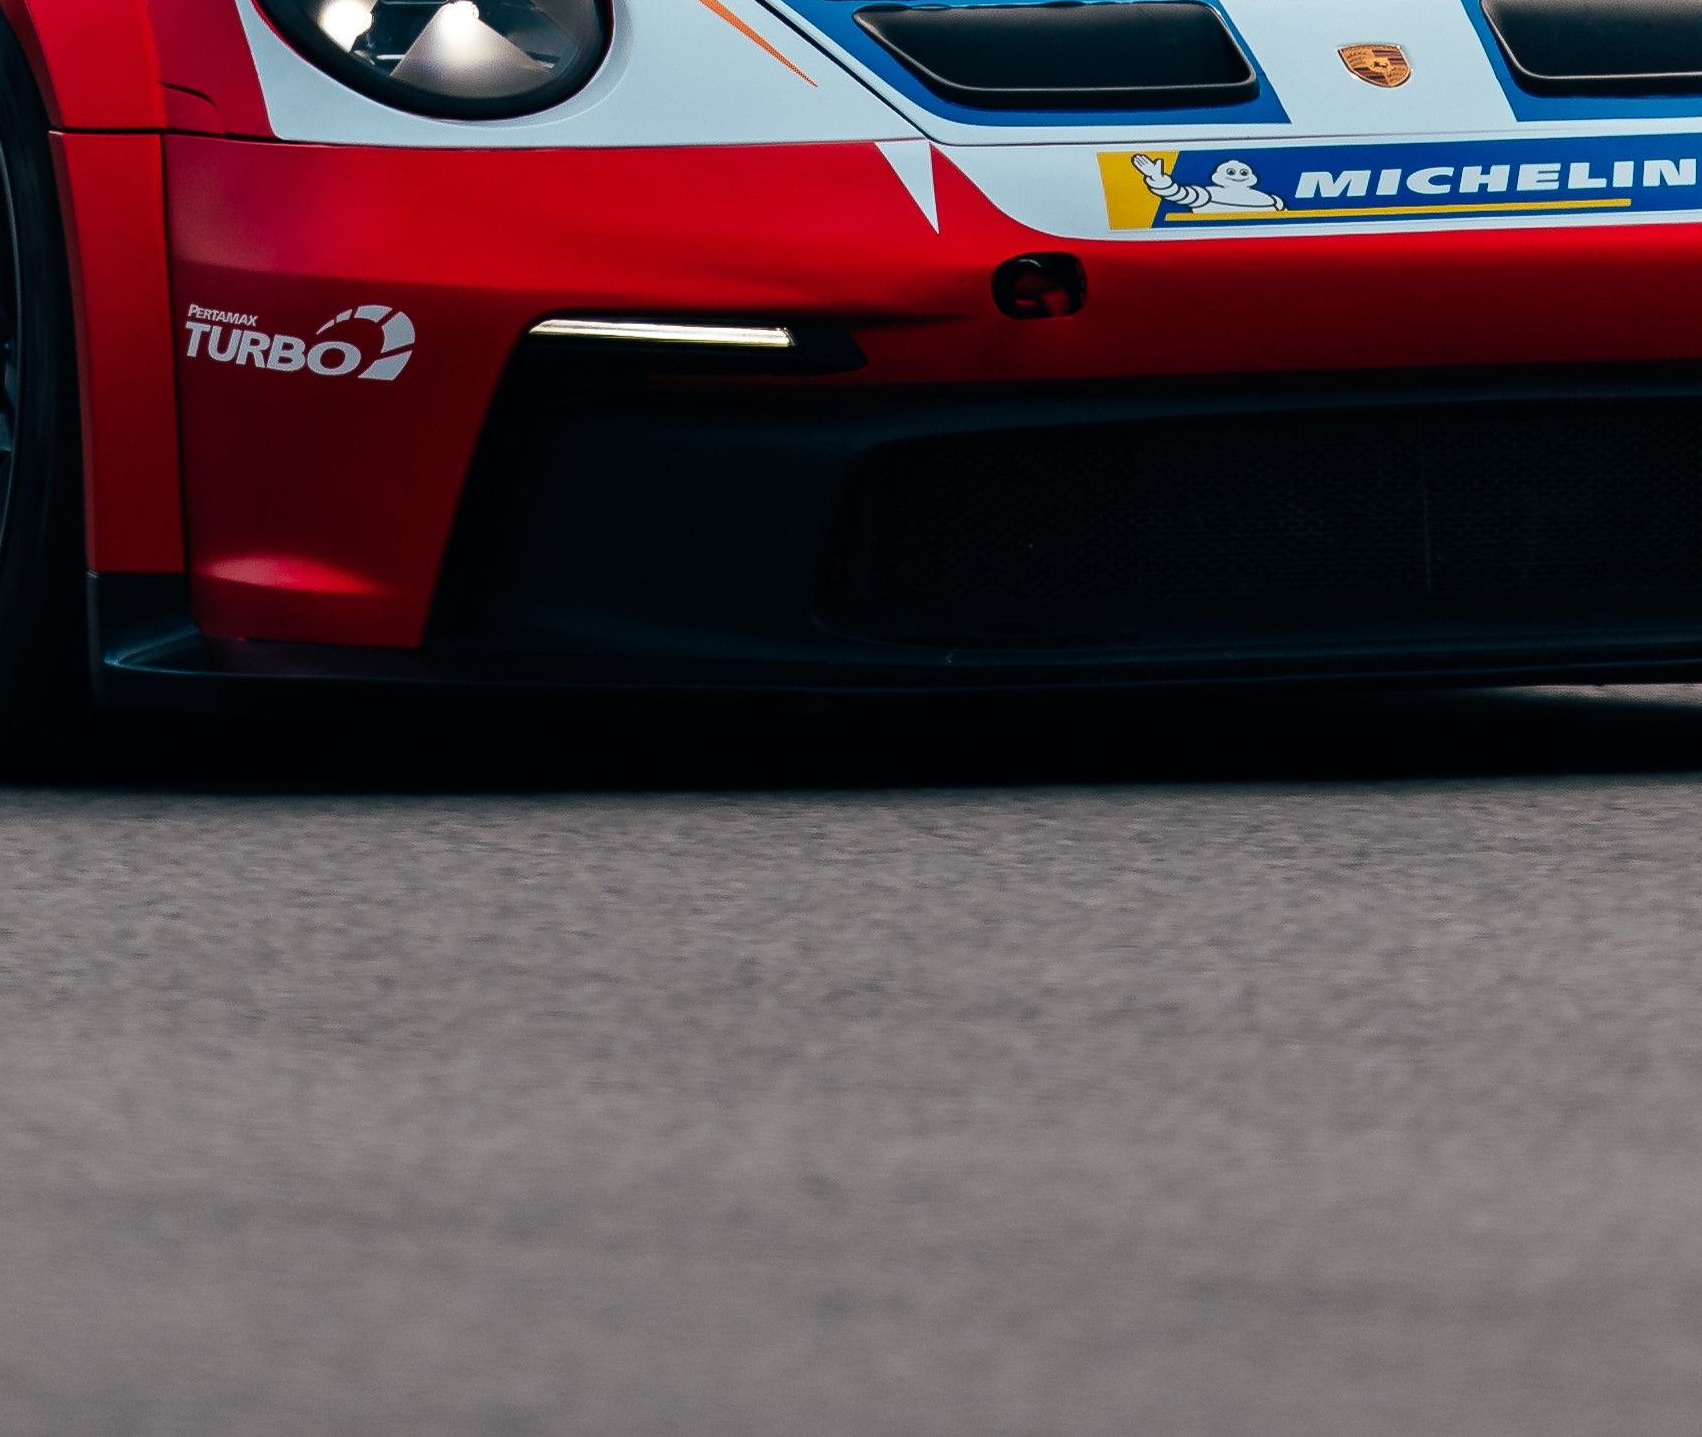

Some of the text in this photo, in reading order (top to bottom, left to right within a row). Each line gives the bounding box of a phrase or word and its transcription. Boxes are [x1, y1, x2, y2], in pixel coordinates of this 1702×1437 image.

[1295, 158, 1697, 199] MICHELIN
[187, 303, 259, 327] PERTAMAX
[185, 321, 362, 376] TURBO
